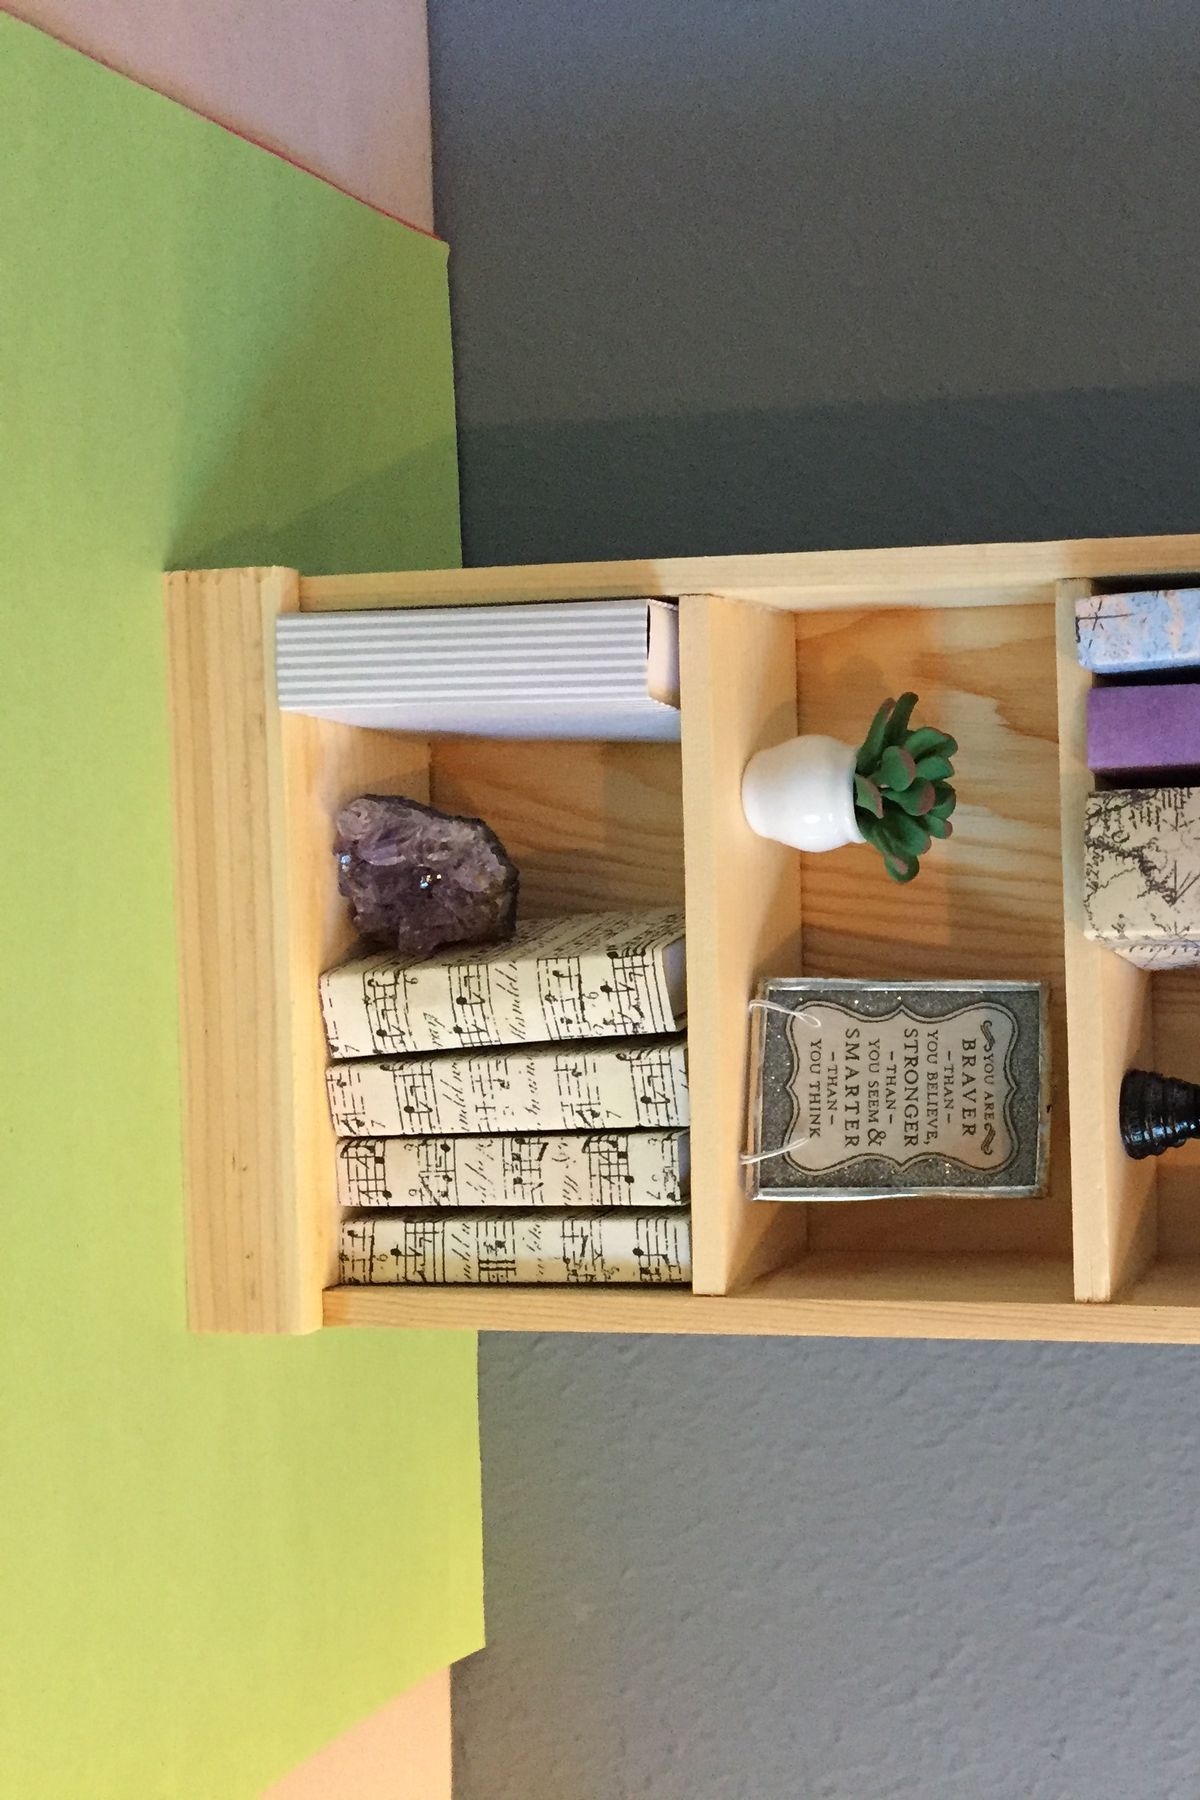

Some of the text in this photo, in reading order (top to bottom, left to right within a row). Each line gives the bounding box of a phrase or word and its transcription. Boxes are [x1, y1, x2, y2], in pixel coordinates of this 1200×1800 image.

[809, 1039, 821, 1138] YOU THINK
[844, 1028, 860, 1148] SMARTER
[868, 1038, 886, 1146] YOU SEEM &
[903, 1028, 919, 1147] STRONGER
[924, 1030, 938, 1145] YOU BELIEVE,
[962, 1039, 977, 1136] BRAVER
[984, 1053, 995, 1120] YOU ARE
